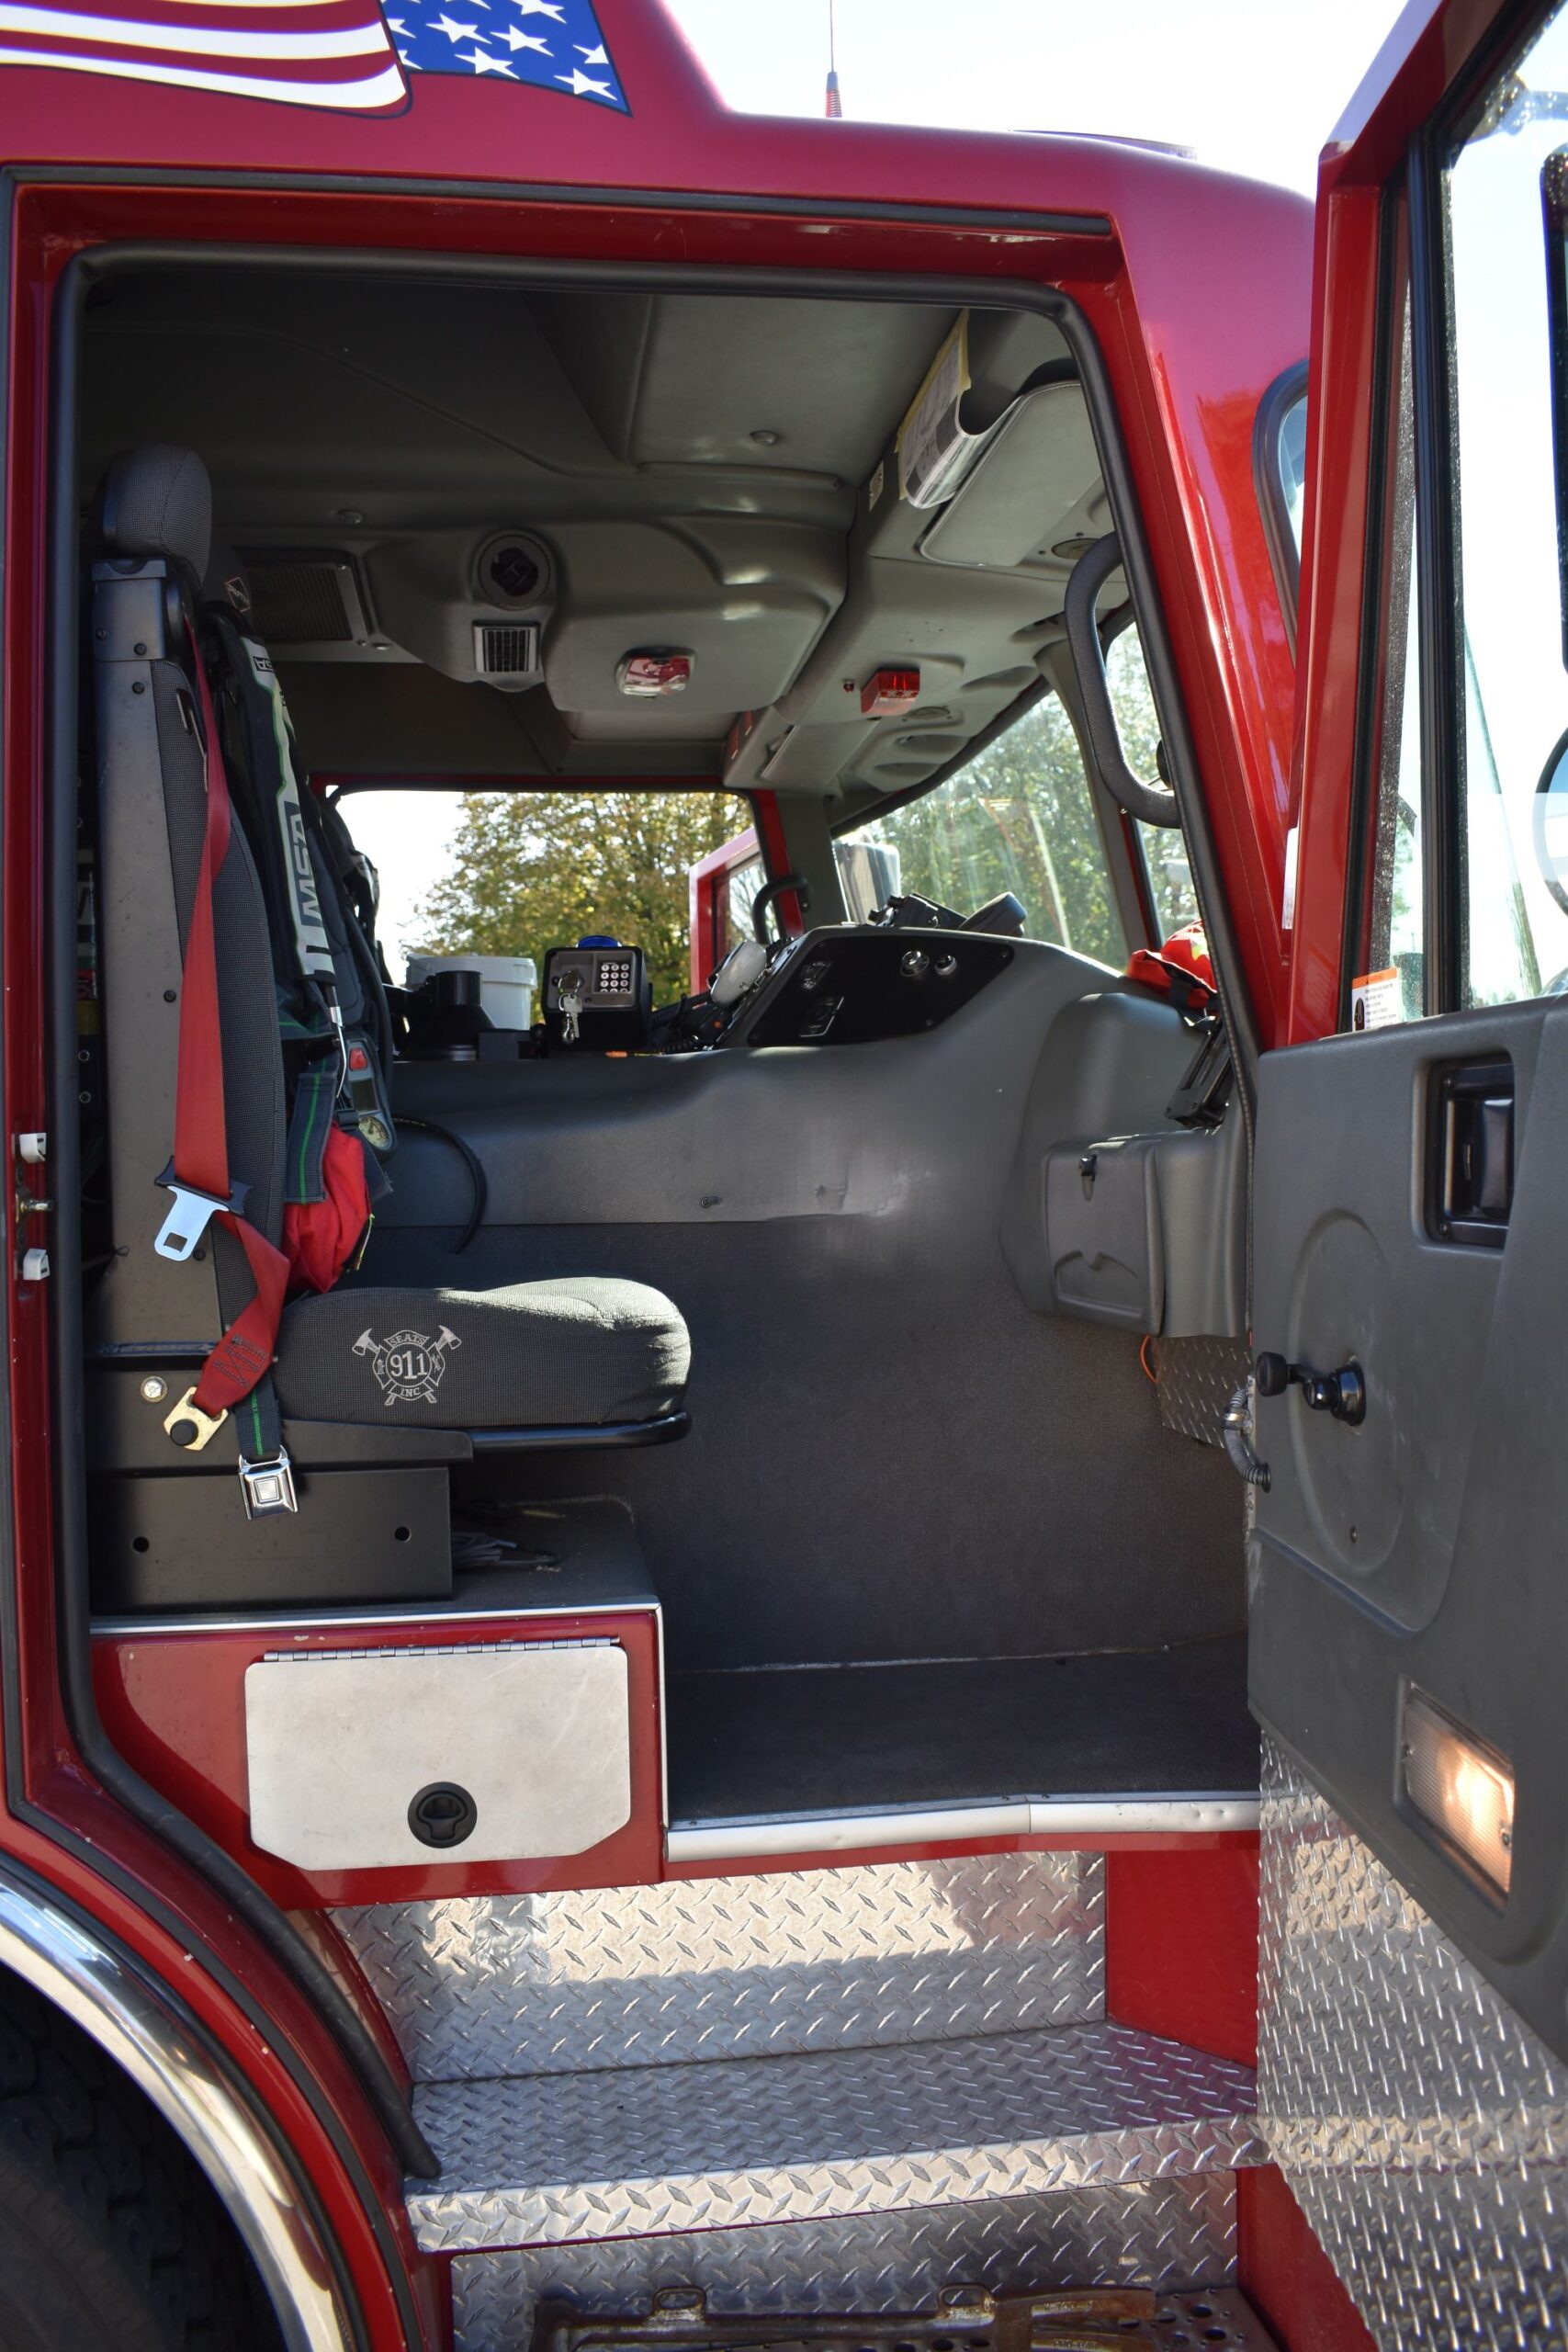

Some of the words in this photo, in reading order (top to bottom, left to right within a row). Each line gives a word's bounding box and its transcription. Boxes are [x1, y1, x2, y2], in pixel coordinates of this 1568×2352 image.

[390, 1334, 425, 1347] SEATS
[389, 1351, 428, 1379] 911
[400, 1387, 421, 1397] INC
